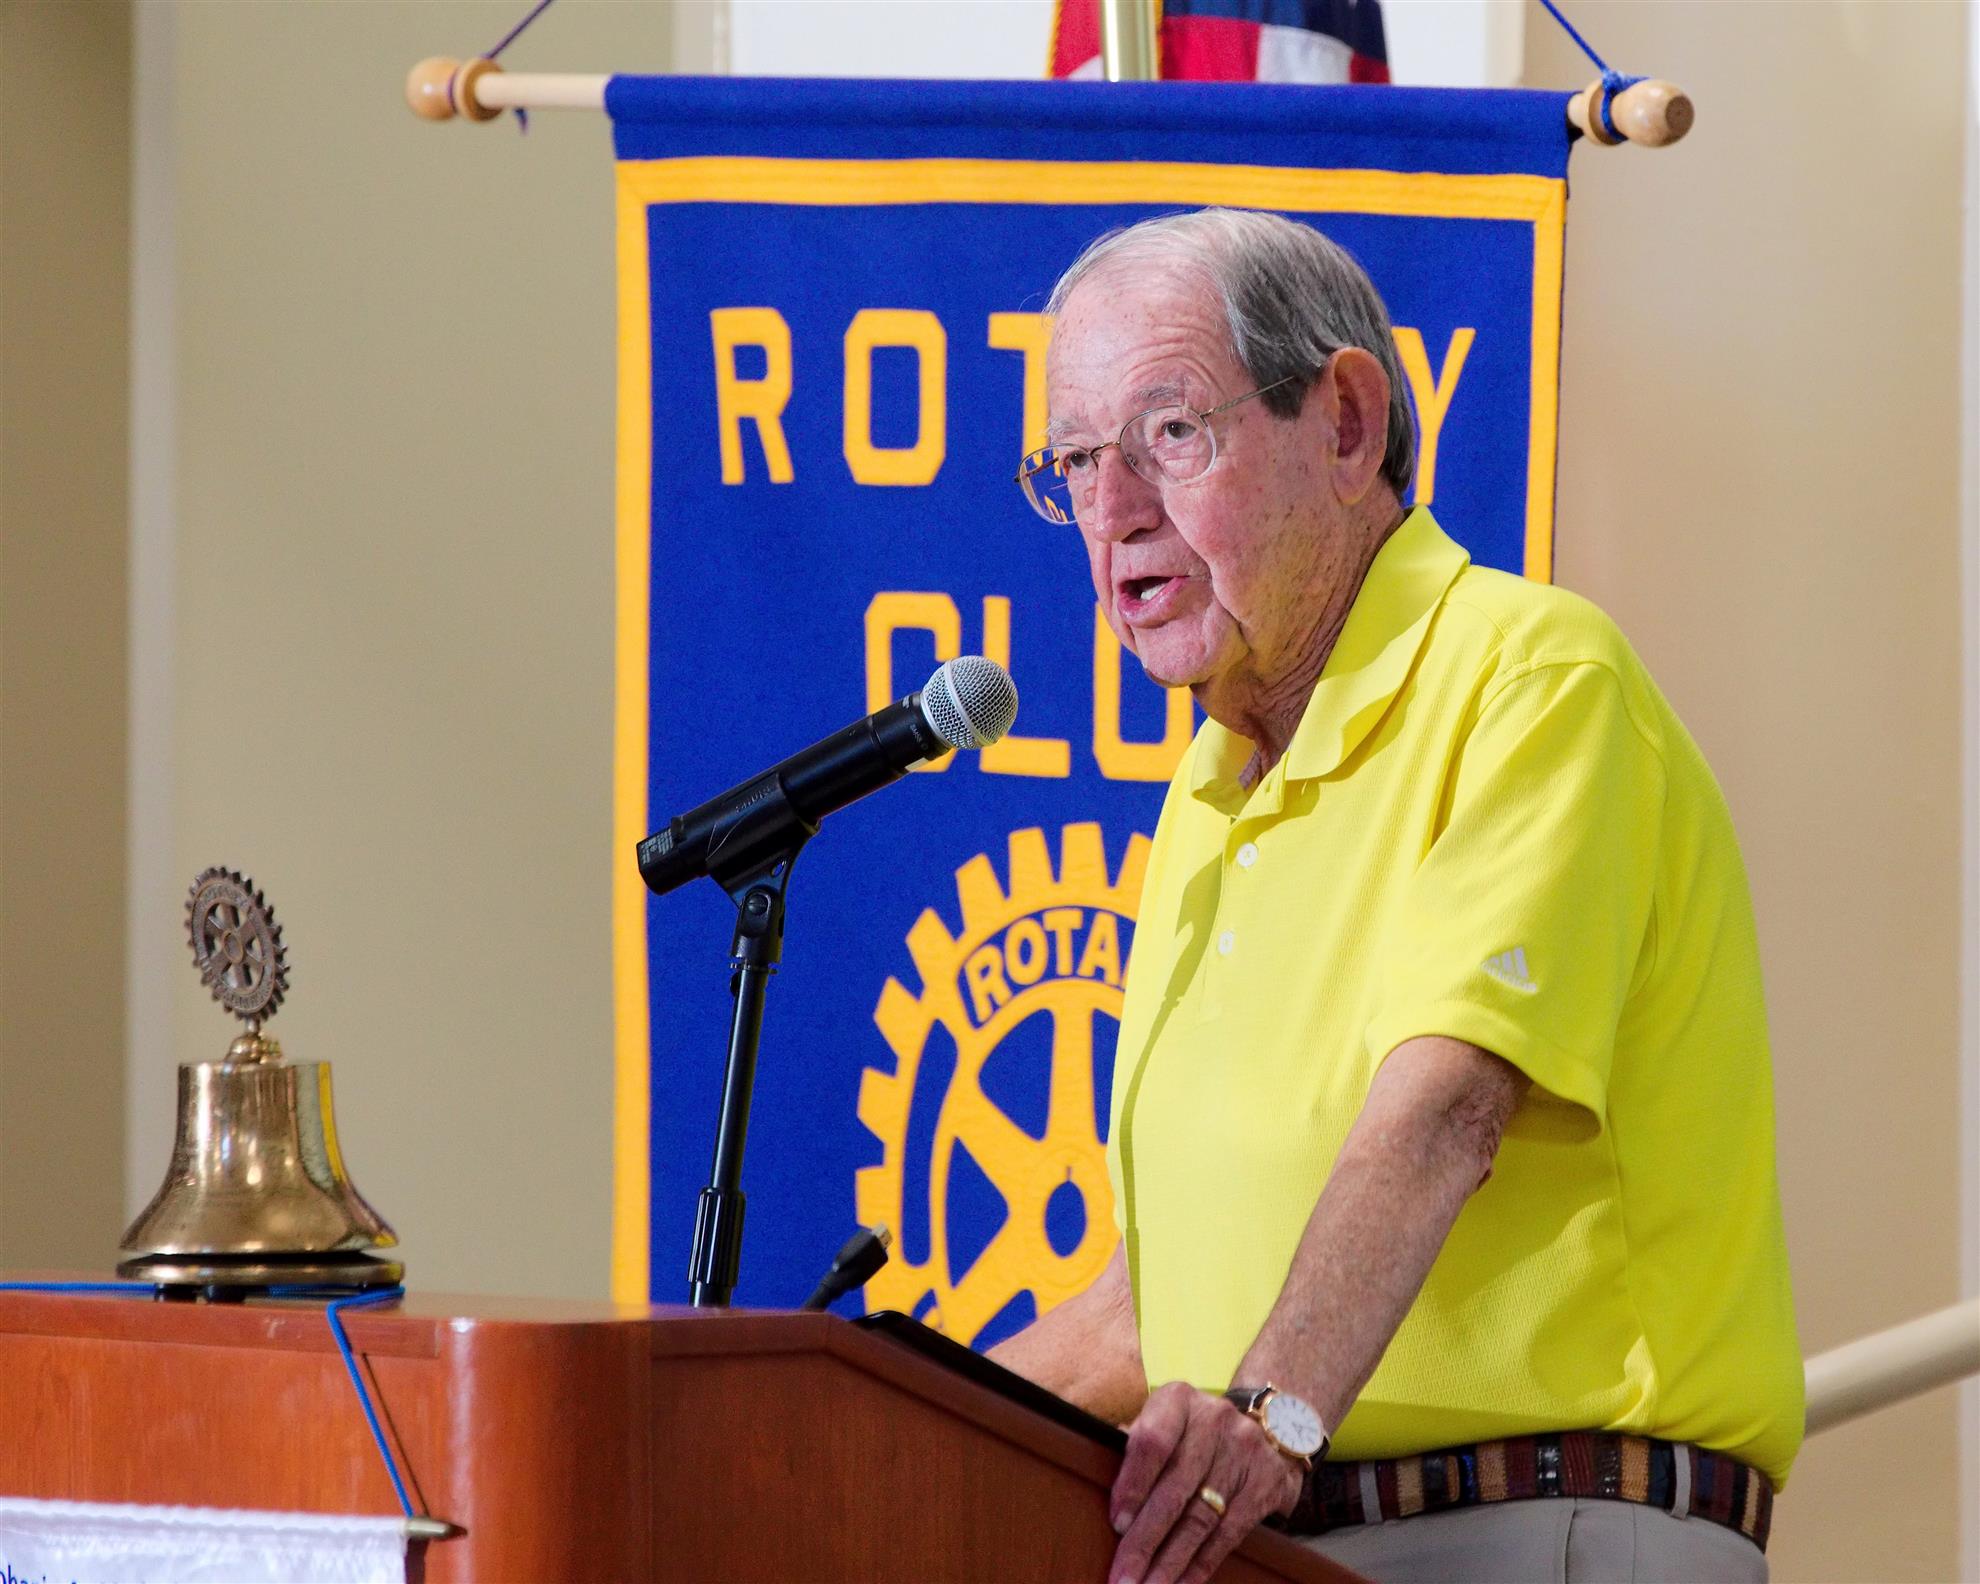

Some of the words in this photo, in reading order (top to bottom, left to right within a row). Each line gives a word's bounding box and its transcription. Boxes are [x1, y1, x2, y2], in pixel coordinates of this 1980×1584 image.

[710, 305, 1477, 506] ROTY
[864, 591, 1196, 782] CLU
[964, 908, 1129, 1023] ROTA
